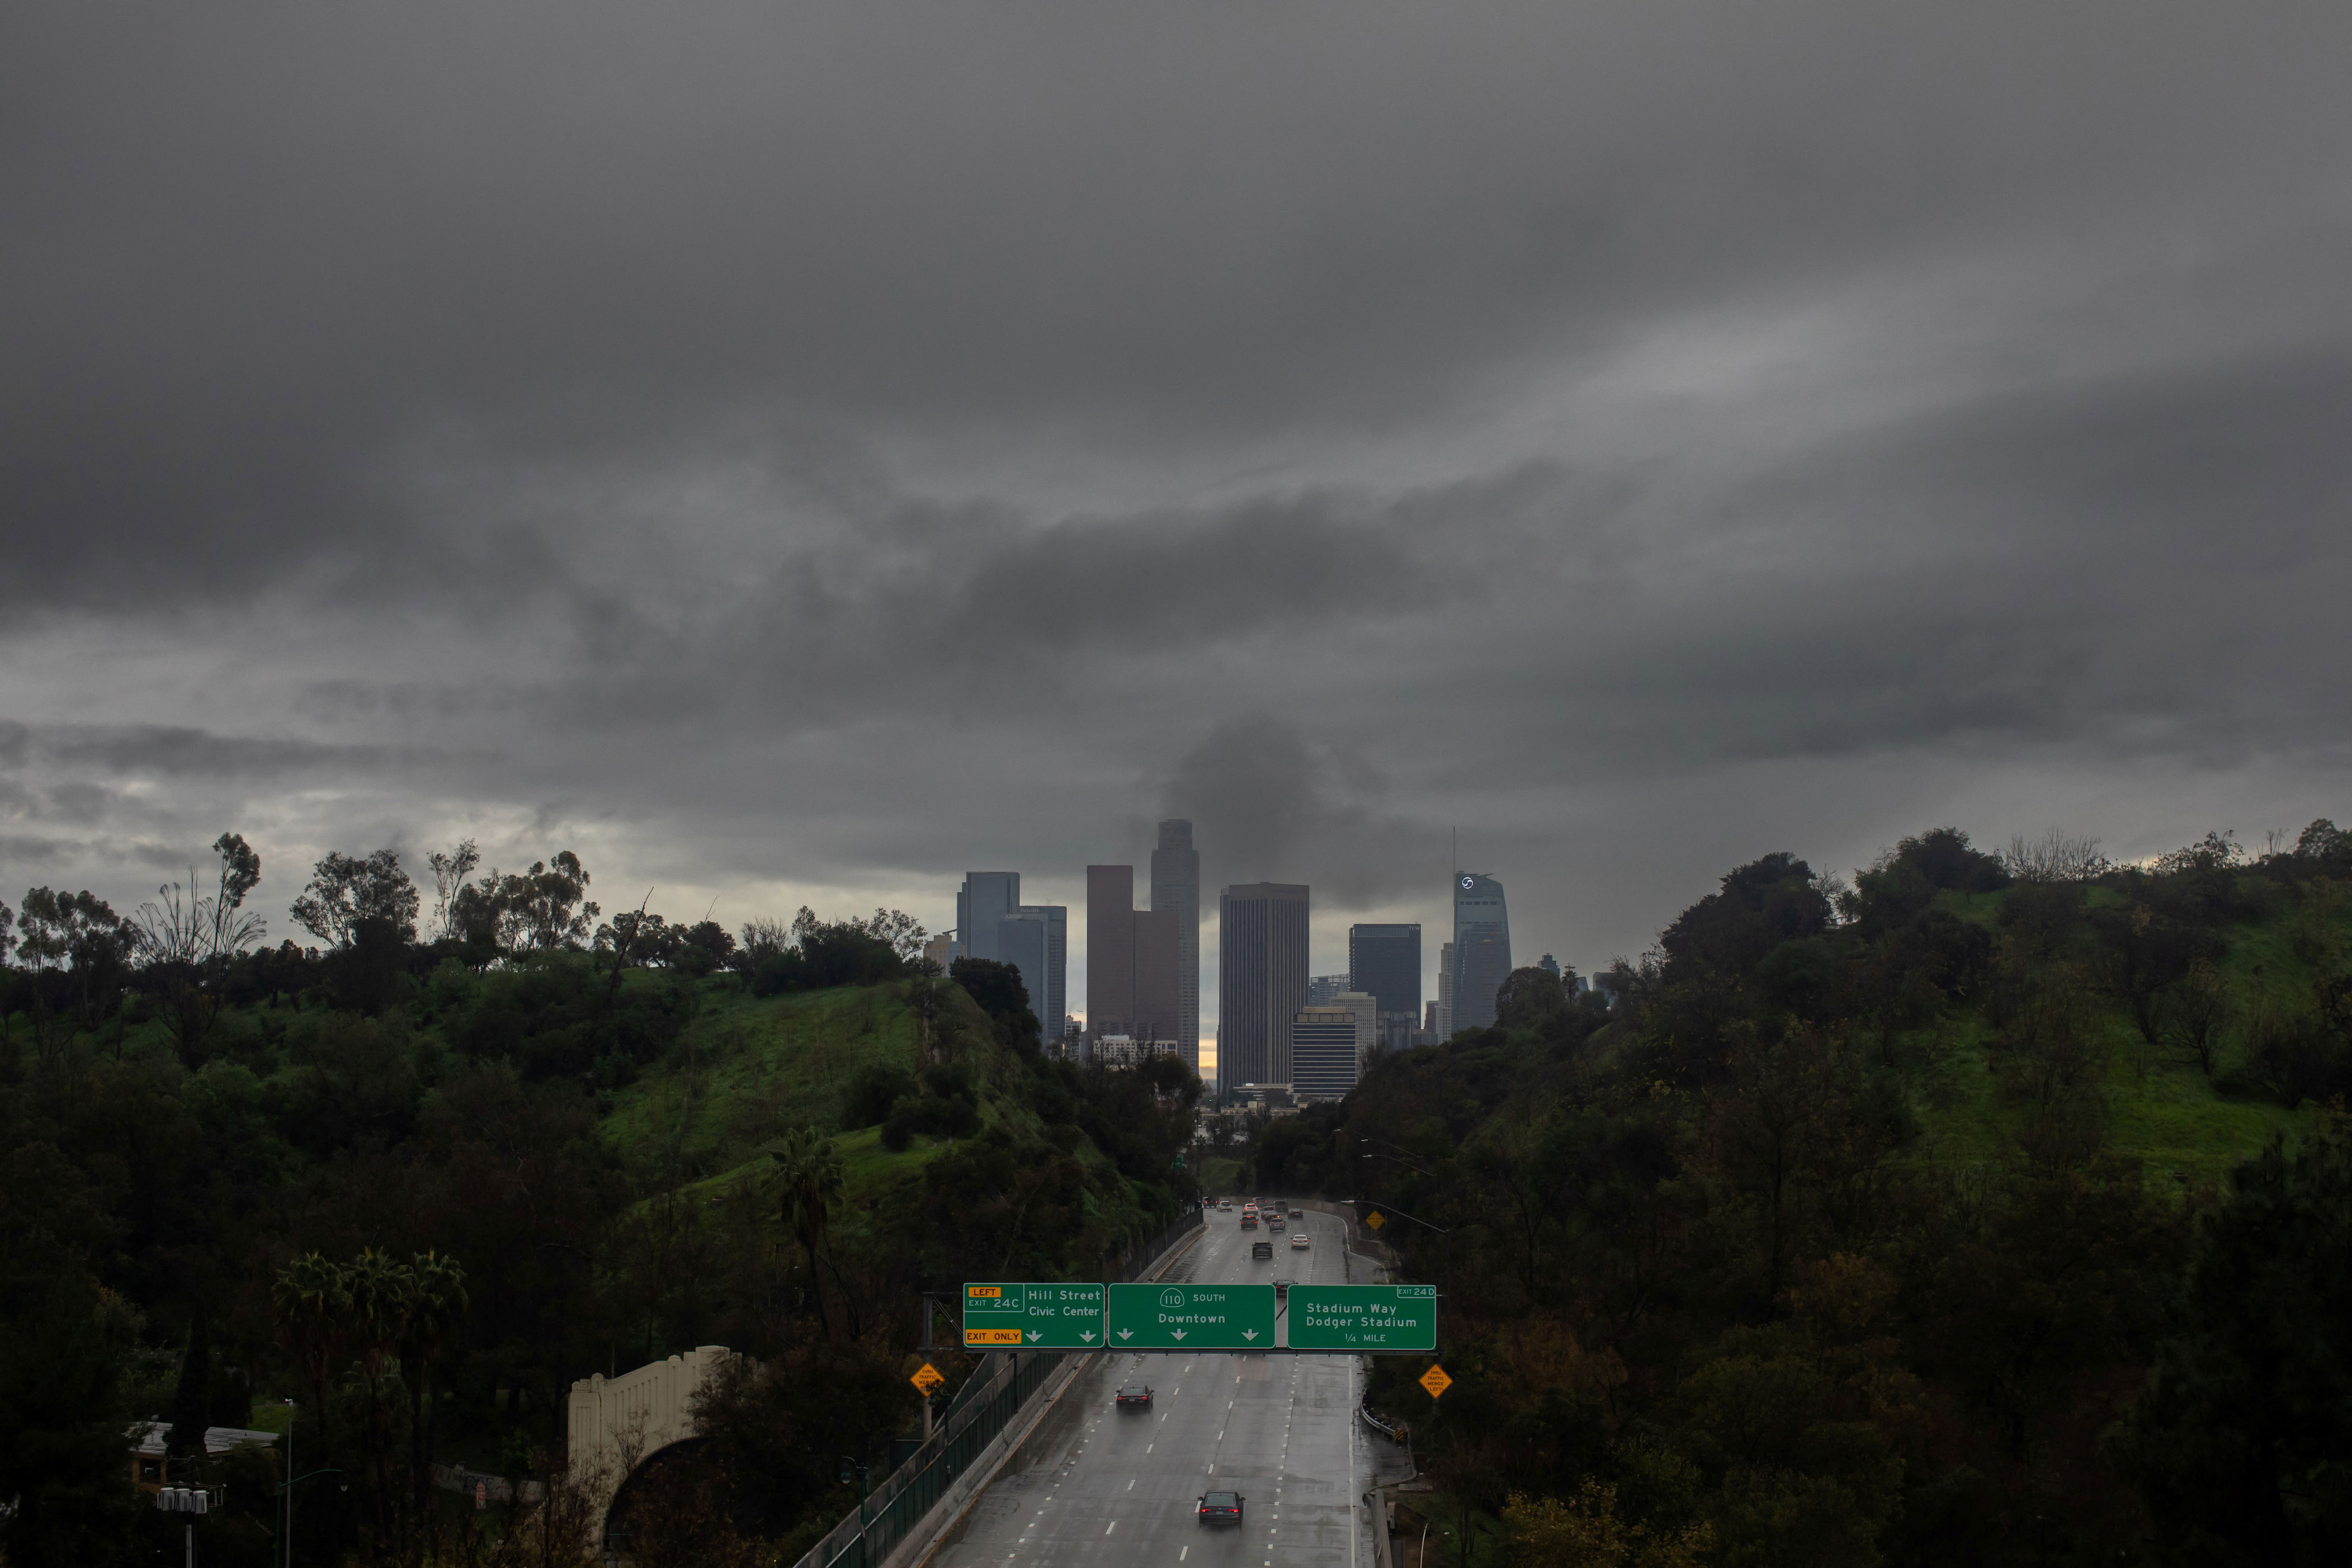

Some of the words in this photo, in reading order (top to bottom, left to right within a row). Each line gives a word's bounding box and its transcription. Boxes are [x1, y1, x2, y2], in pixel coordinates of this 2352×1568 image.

[1028, 1290, 1052, 1300] Hill
[1060, 1290, 1101, 1300] Street
[1164, 1295, 1181, 1305] 110
[994, 1298, 1019, 1308] 24C
[1029, 1306, 1055, 1316] Civic
[1062, 1306, 1099, 1316] Center
[1307, 1303, 1362, 1314] Stadium
[1370, 1303, 1397, 1315] Way
[1159, 1313, 1225, 1324] Downtown
[1306, 1316, 1353, 1329] Dodger
[1361, 1317, 1416, 1327] Stadium
